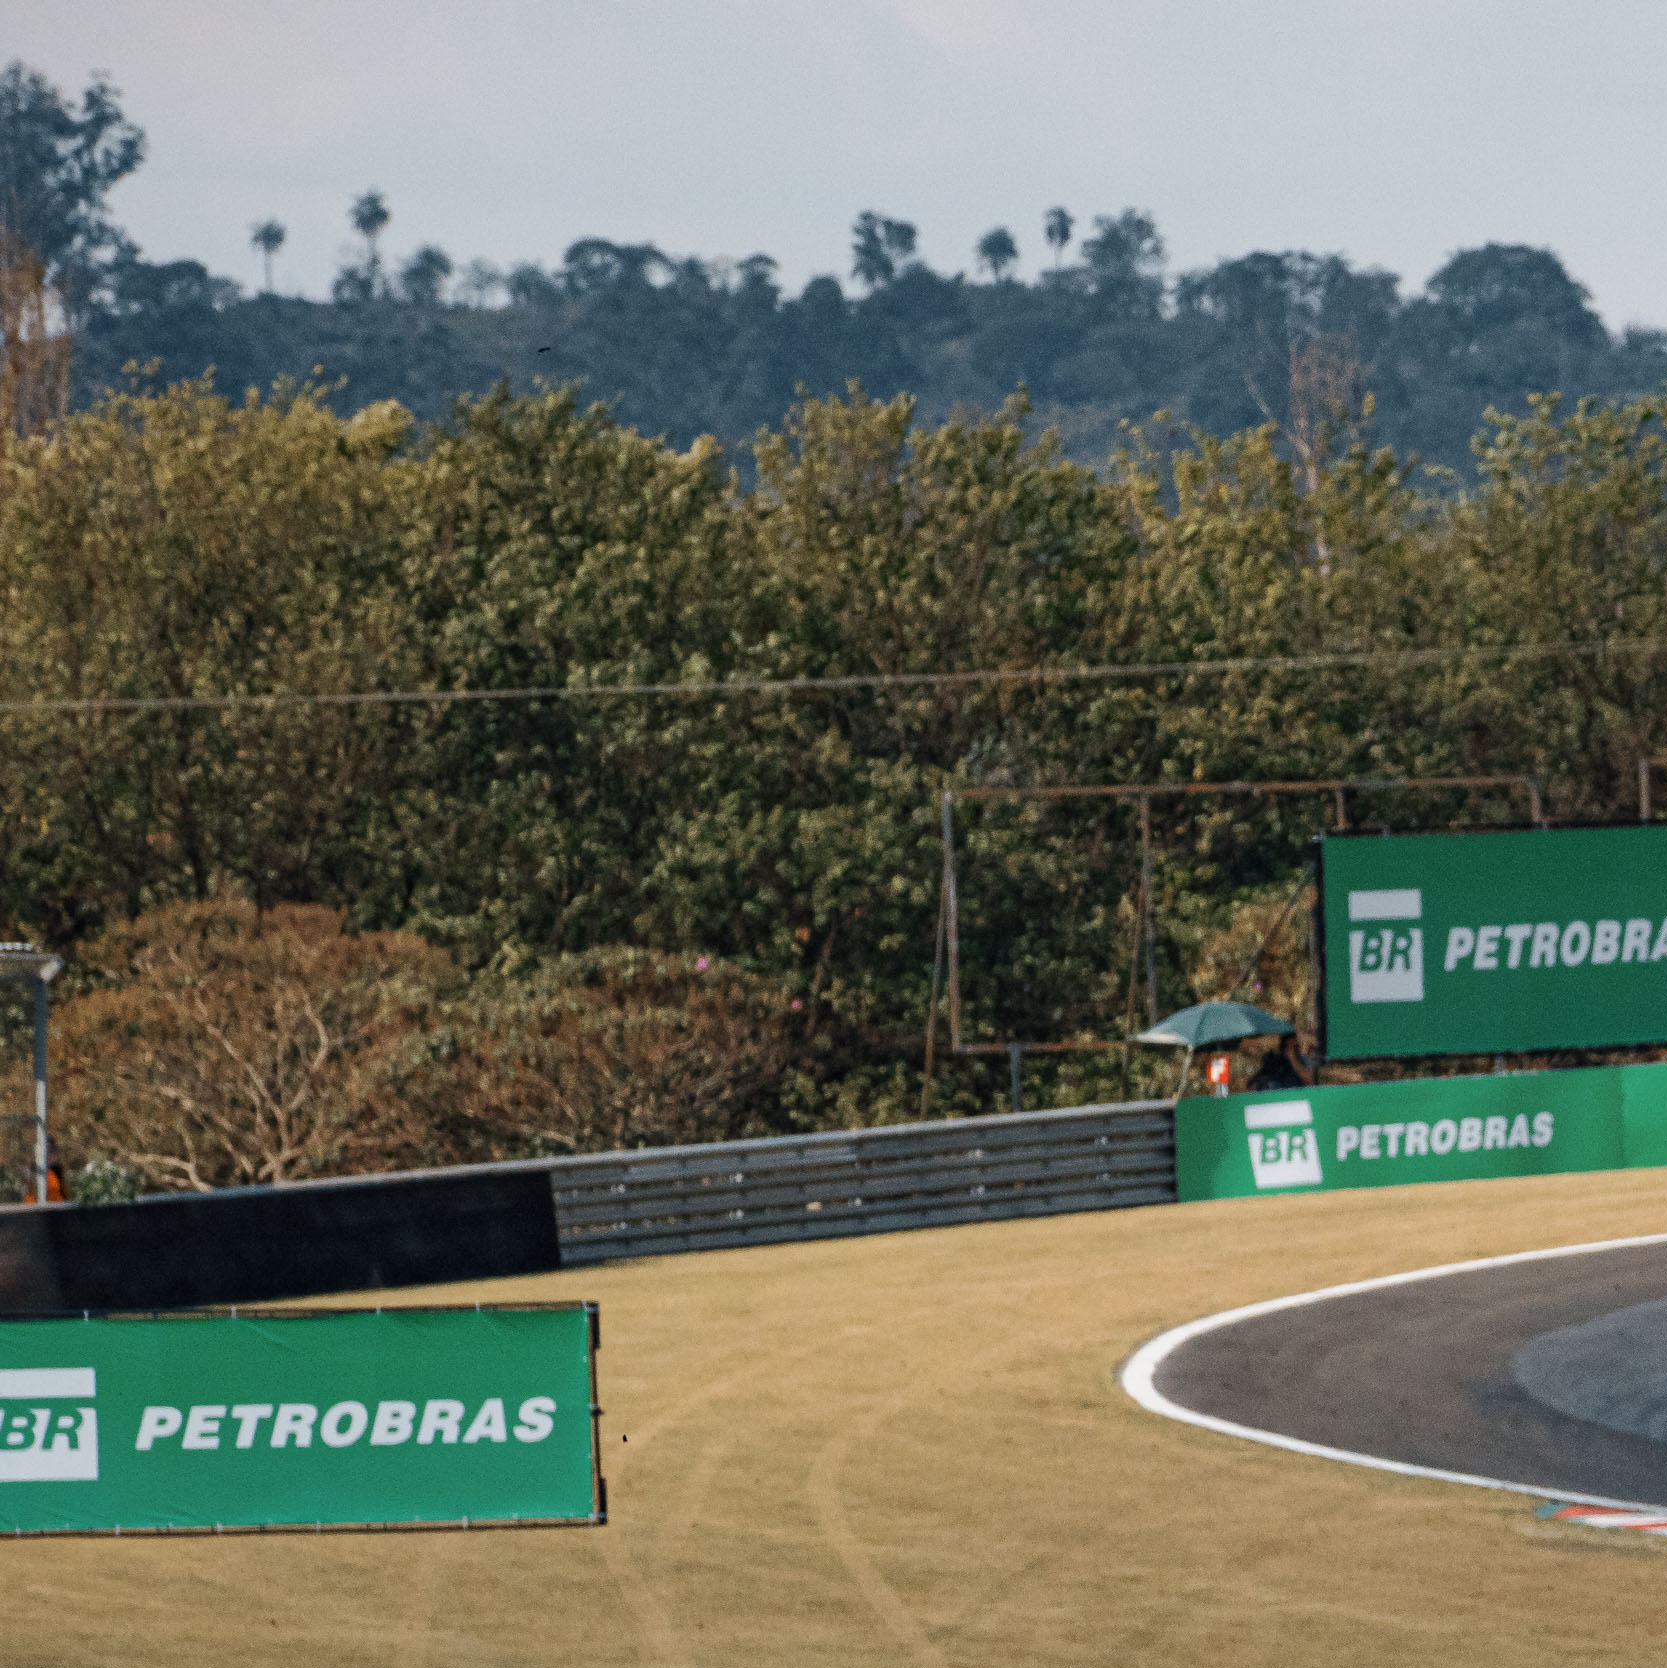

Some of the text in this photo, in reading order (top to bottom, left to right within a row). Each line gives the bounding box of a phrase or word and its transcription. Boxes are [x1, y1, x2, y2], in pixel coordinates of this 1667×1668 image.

[1365, 929, 1412, 971] BR
[1258, 1111, 1555, 1165] BR PETROBRAS
[135, 1395, 557, 1451] PETROBRAS
